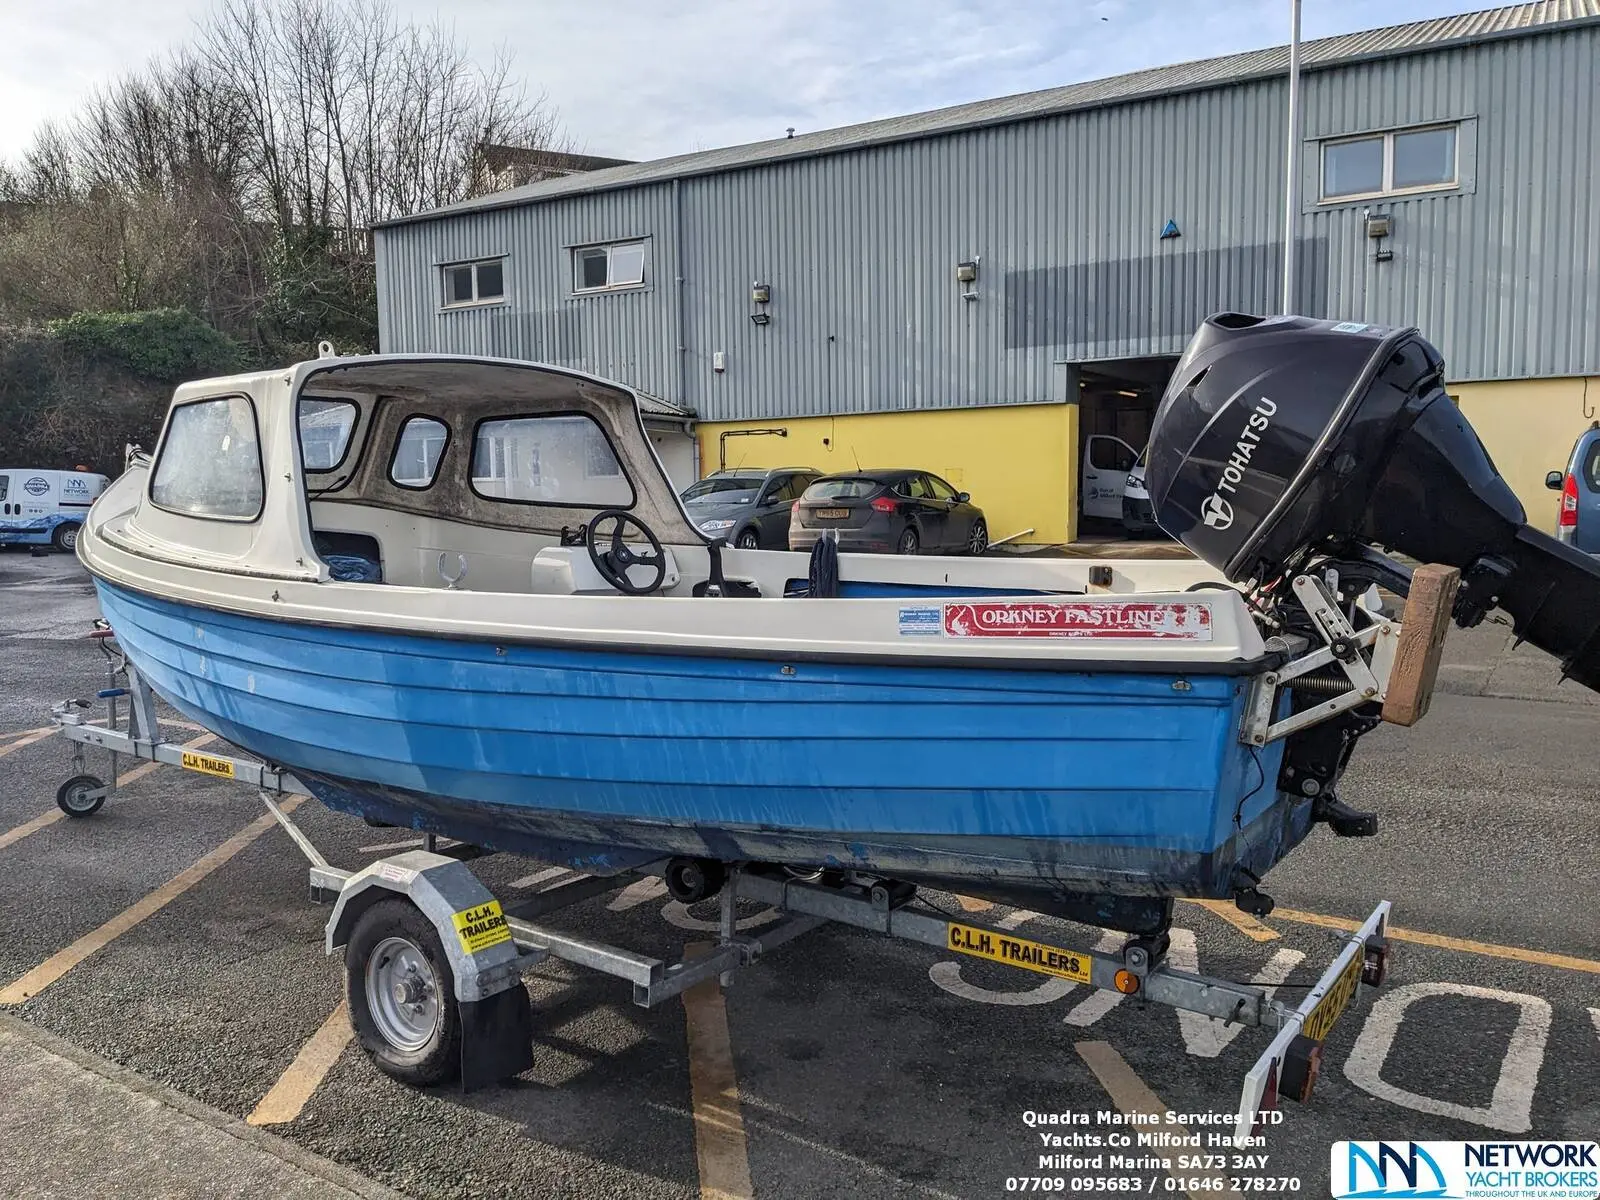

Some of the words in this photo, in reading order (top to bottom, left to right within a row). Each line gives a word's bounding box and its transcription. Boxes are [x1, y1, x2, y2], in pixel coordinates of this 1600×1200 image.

[1217, 396, 1277, 493] TOHATSU
[982, 609, 1062, 624] ORKNEY
[183, 753, 199, 768] C.L.H.
[201, 758, 230, 774] TRAILERS
[465, 906, 494, 923] C.L.H.
[459, 915, 507, 939] TRAILERS
[950, 927, 995, 955] C.L.H.
[999, 939, 1080, 973] TRAILERS
